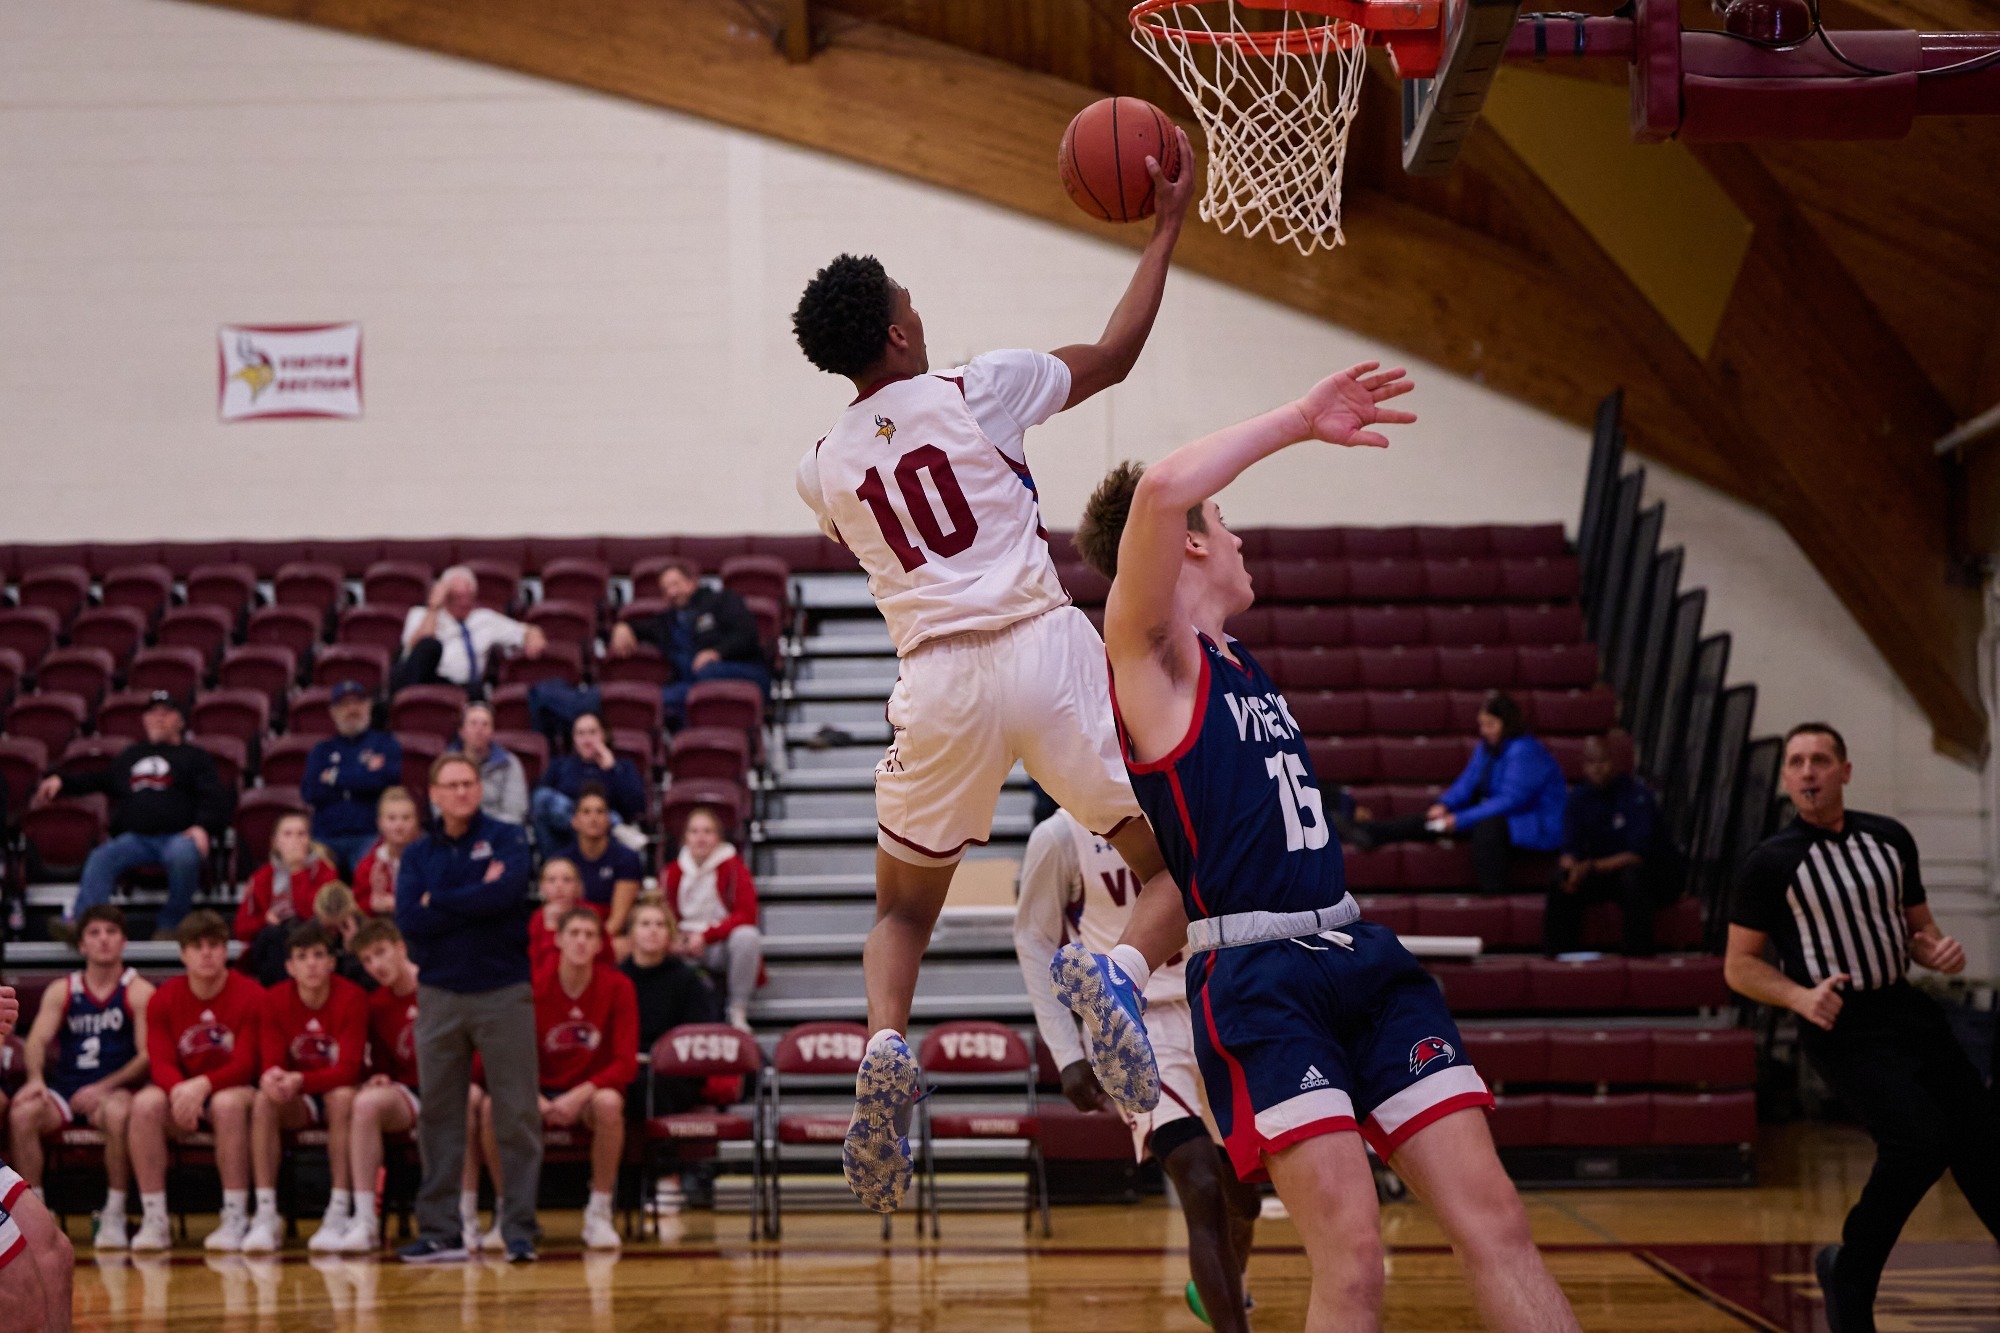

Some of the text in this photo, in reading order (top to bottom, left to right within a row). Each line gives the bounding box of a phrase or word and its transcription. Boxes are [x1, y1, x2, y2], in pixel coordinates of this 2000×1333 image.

[856, 443, 979, 574] 10
[1265, 751, 1330, 852] 15
[76, 1036, 100, 1069] 2
[672, 1034, 740, 1063] VCSU
[796, 1032, 866, 1062] VCSU
[939, 1032, 1007, 1061] VCSU
[1300, 1078, 1330, 1090] adidas
